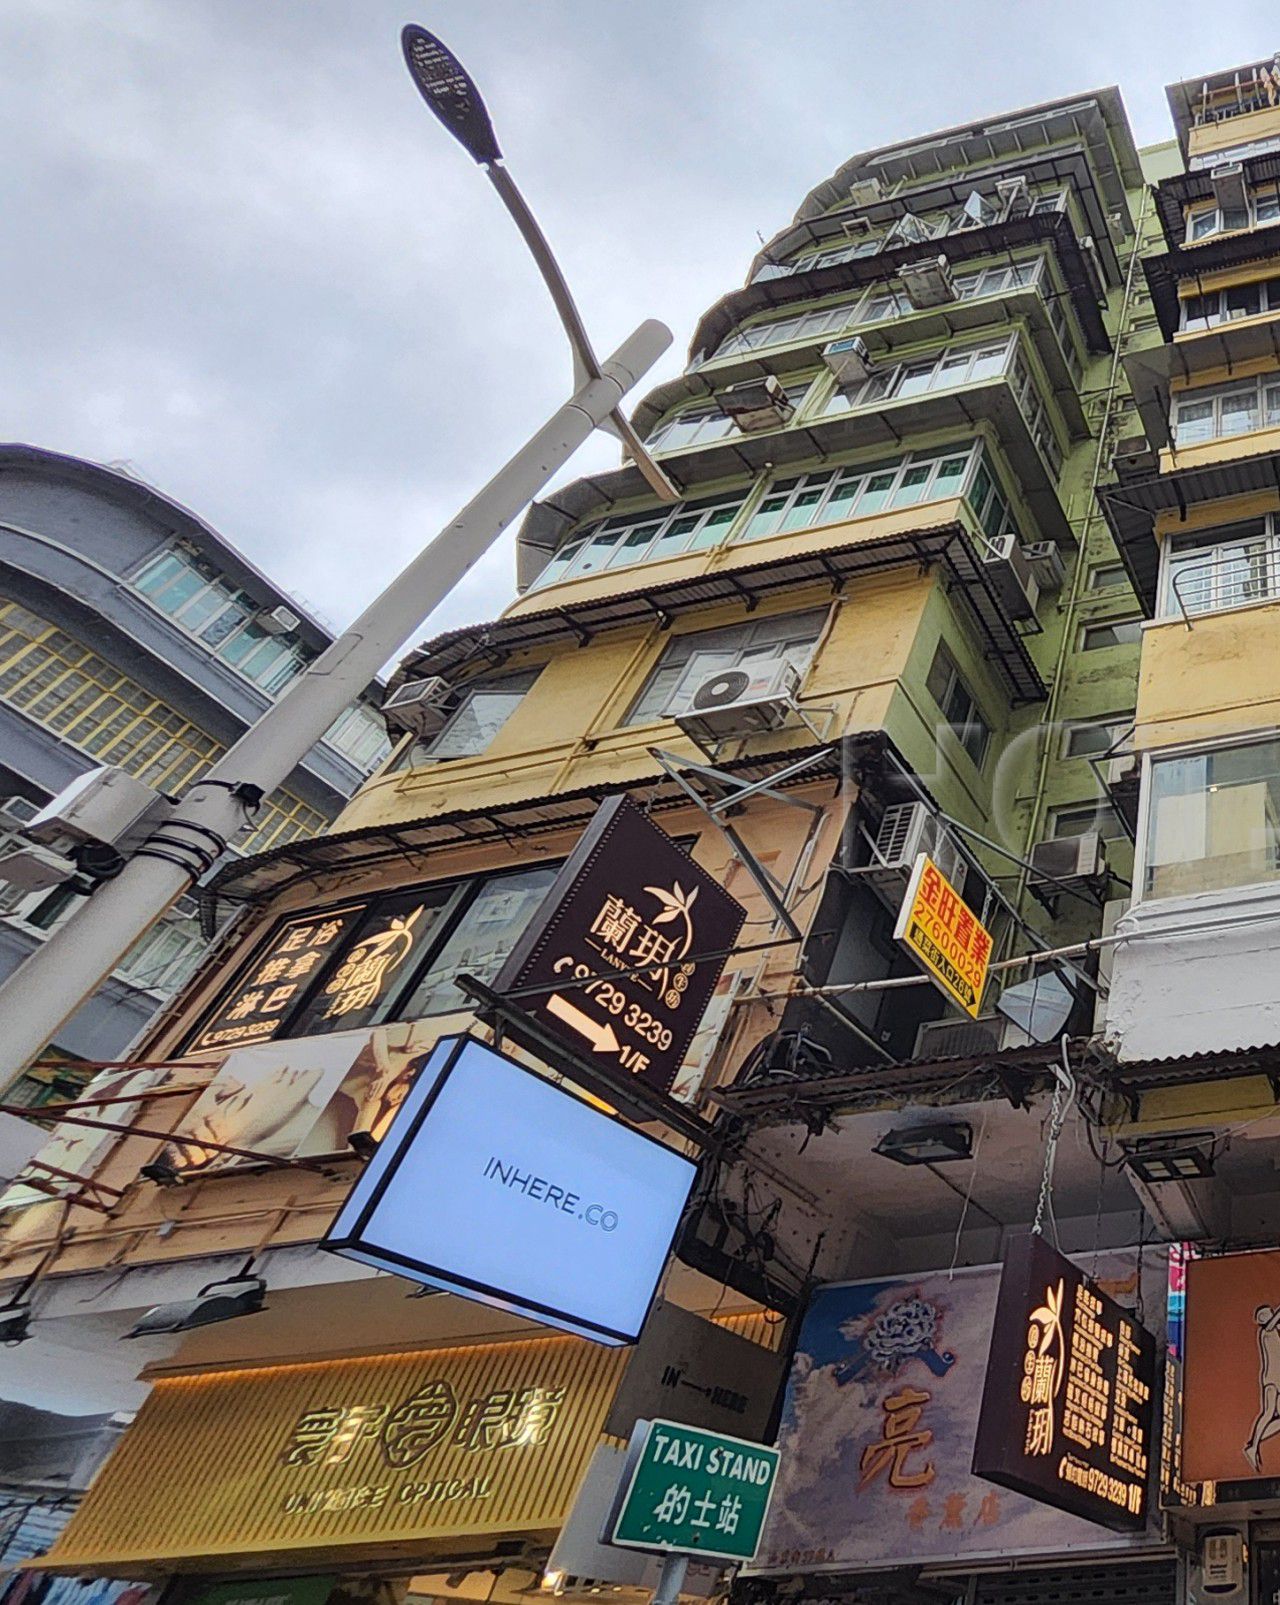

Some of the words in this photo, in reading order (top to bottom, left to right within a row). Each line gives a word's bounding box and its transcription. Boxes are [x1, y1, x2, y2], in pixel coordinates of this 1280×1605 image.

[276, 918, 344, 954] 足浴
[920, 866, 990, 971] 金旺置業
[249, 951, 322, 987] 推拿
[914, 901, 982, 989] 27600029
[225, 983, 298, 1021] 淋巴
[623, 1003, 673, 1051] 3239
[618, 1044, 651, 1074] 1/F
[482, 1156, 619, 1232] INHERE.CO
[652, 1434, 705, 1471] TAXI
[705, 1446, 771, 1486] STAND
[652, 1482, 743, 1536] 的士站
